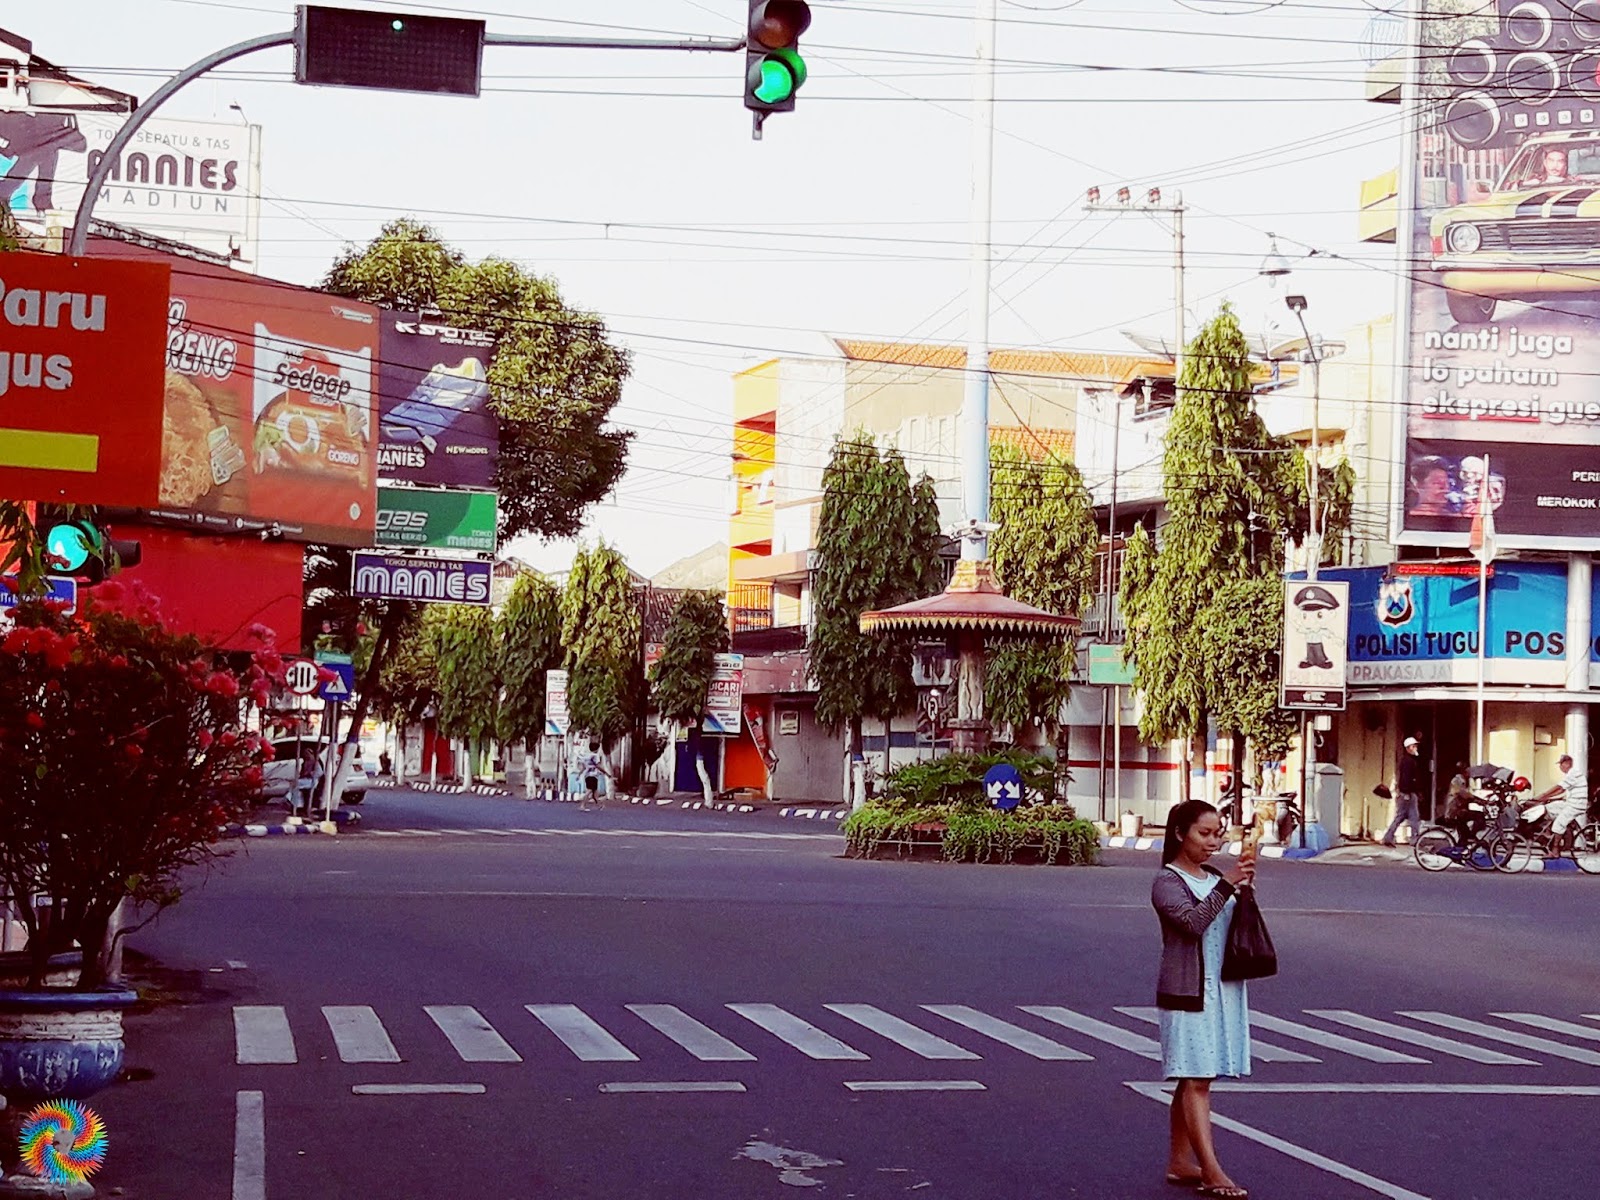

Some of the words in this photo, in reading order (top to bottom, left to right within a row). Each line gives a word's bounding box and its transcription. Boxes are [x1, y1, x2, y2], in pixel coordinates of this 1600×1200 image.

[192, 135, 201, 148] &
[206, 138, 231, 150] TAS
[86, 148, 238, 192] MANIES
[97, 189, 228, 213] MADIUN
[1423, 326, 1499, 351] nanti
[1507, 326, 1572, 358] juga
[273, 362, 351, 401] Sedaap
[1422, 357, 1450, 382] lo
[1457, 360, 1558, 388] paham
[1422, 390, 1540, 421] ekspresi
[1537, 495, 1596, 508] MEROKOK
[384, 558, 407, 567] TOKO
[408, 559, 440, 570] SEPATU
[448, 563, 464, 571] TAS
[356, 565, 488, 601] MANIES
[1355, 632, 1418, 656] POLISI
[1425, 631, 1480, 656] TUGU
[1505, 630, 1565, 656] POS
[1353, 664, 1425, 681] PRAKASA
